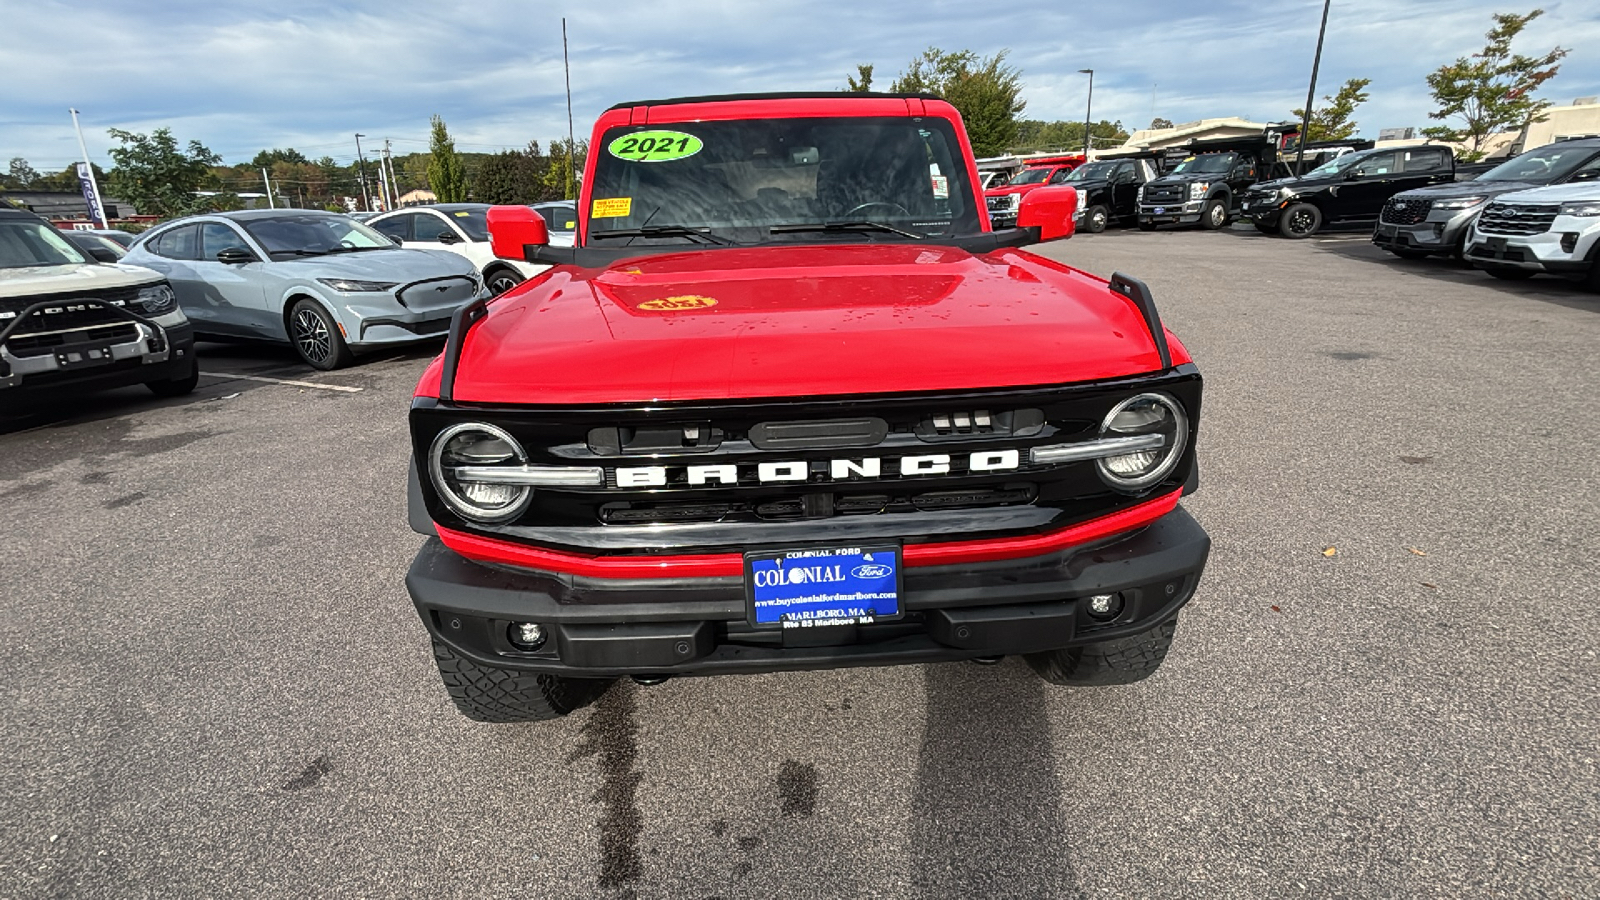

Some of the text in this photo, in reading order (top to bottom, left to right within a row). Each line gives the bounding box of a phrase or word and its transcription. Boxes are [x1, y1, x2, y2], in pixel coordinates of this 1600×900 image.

[618, 137, 690, 154] 2021
[615, 449, 1019, 488] BRONCO
[786, 547, 861, 559] COLONIAL FORD
[754, 565, 885, 588] COLONIAL Ford
[754, 592, 897, 608] www.buycolonialfordmarlboro.com
[848, 607, 866, 617] MA
[783, 621, 799, 629] Rte
[801, 619, 814, 628] 85
[814, 617, 855, 627] Marlboro
